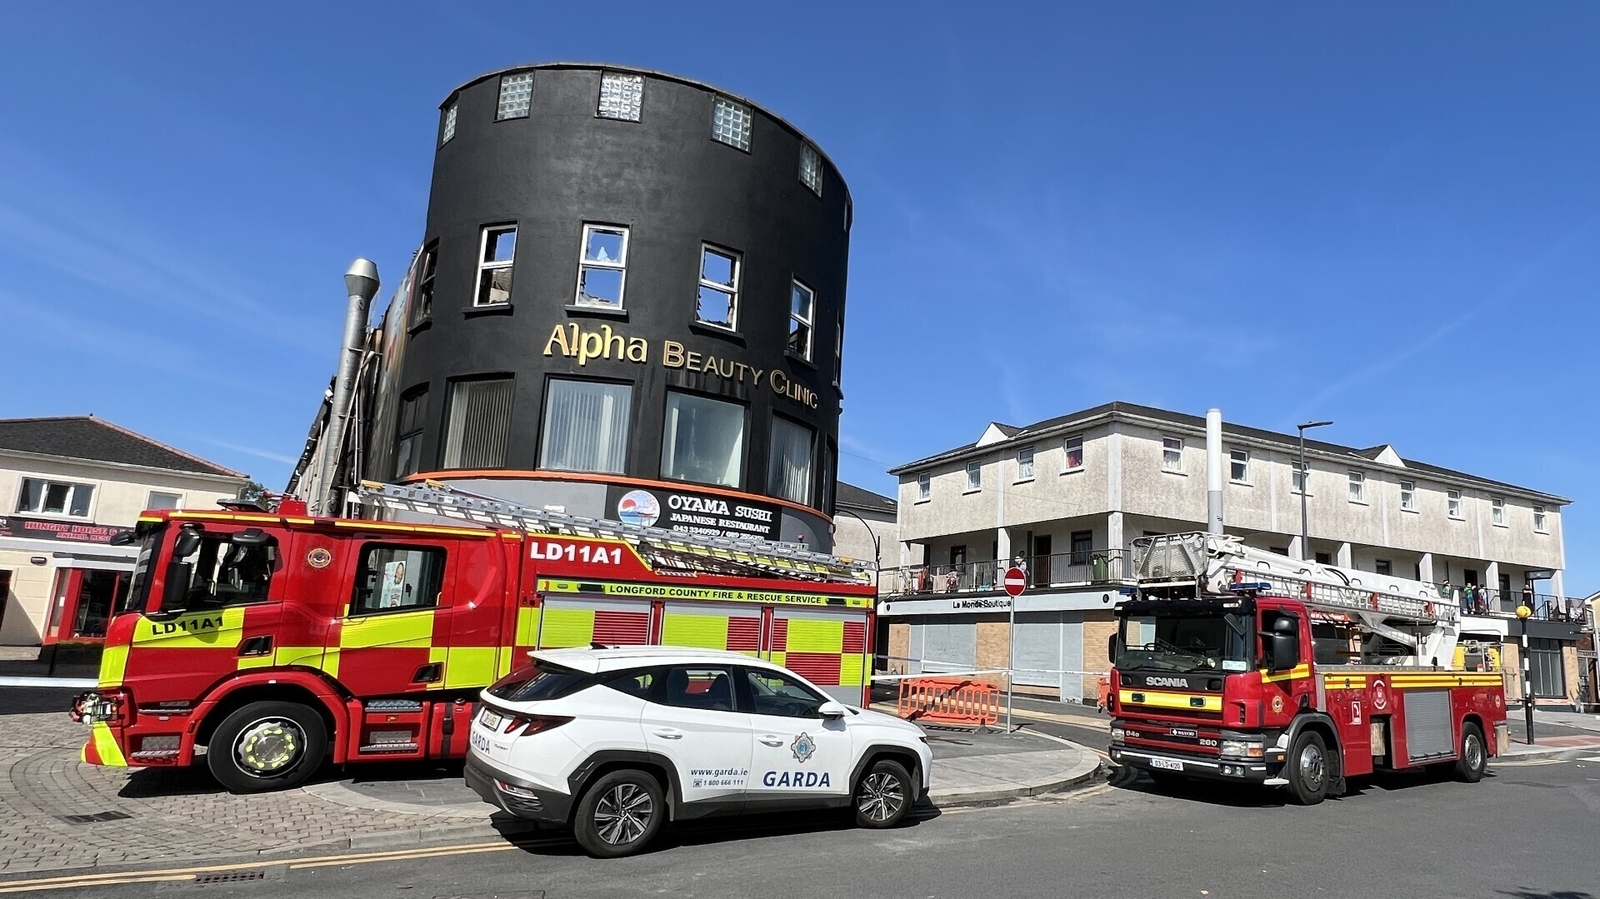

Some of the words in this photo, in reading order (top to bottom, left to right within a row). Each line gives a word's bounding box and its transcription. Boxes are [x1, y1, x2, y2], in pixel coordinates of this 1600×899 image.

[543, 322, 648, 366] Alpha
[668, 495, 730, 516] OYAMA
[734, 506, 772, 522] SUSHI
[25, 521, 70, 533] HUNGRY
[71, 525, 108, 535] HORSE
[670, 513, 717, 526] JAPANESE
[718, 519, 770, 534] RESTAURANT
[673, 525, 688, 533] 043
[56, 532, 89, 541] ANIMAL
[530, 541, 622, 565] LD11A1
[610, 585, 666, 596] LONGFORD
[669, 587, 710, 598] COUNTY
[712, 591, 734, 600] FIRE
[736, 592, 743, 600] &
[747, 593, 782, 603] RESCUE
[785, 595, 822, 604] SERVICE
[152, 616, 223, 636] LD11A1
[1146, 676, 1189, 688] SCANIA
[472, 731, 491, 754] GARDA
[690, 768, 748, 778] www.garda.ie
[763, 771, 830, 788] GARDA
